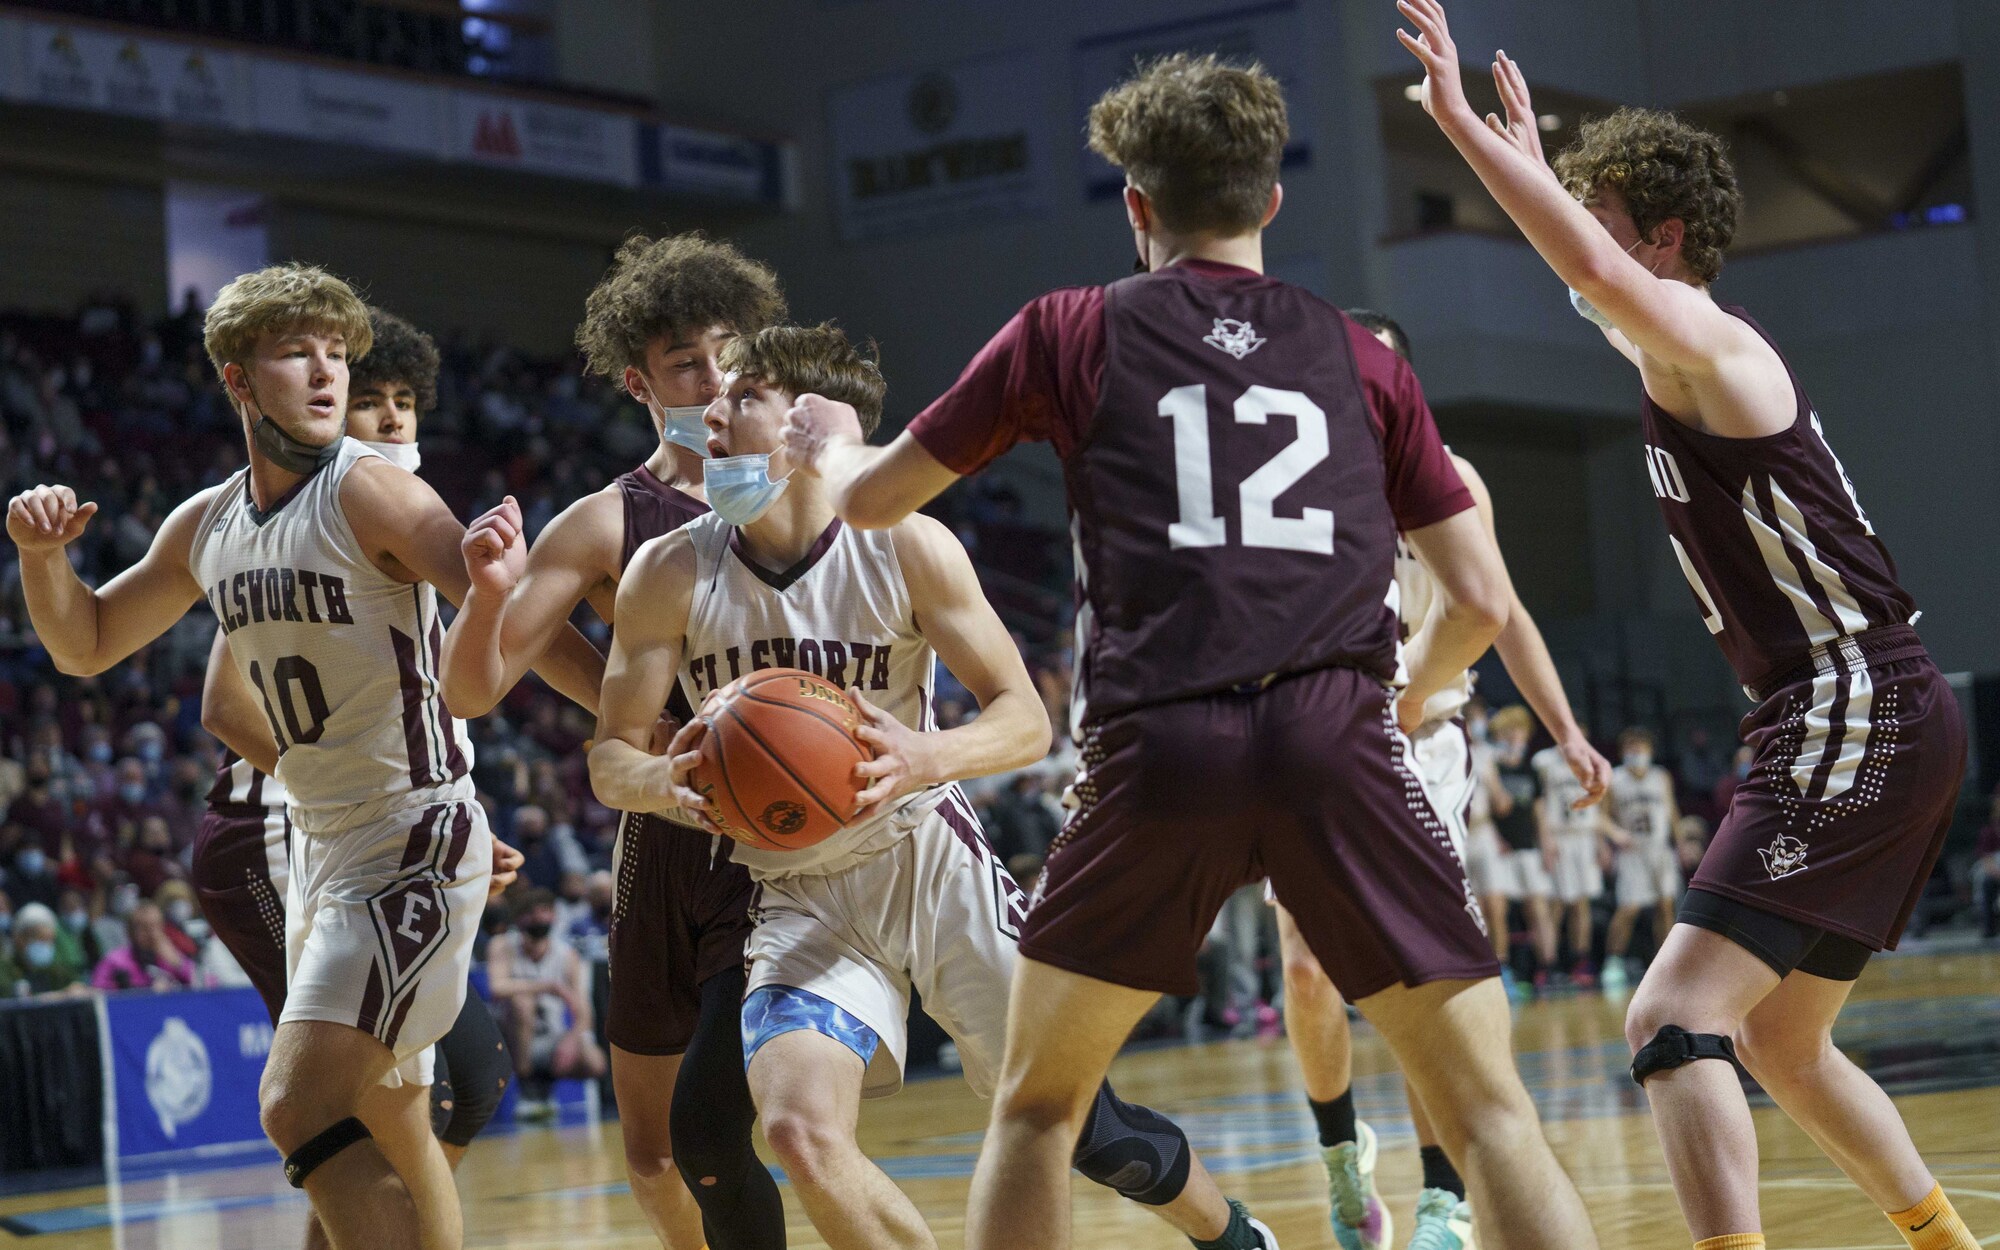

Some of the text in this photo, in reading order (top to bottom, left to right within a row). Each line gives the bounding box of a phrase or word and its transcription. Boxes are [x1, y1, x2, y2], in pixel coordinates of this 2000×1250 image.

[1157, 383, 1335, 556] 12
[250, 654, 331, 757] 10
[396, 890, 432, 944] E
